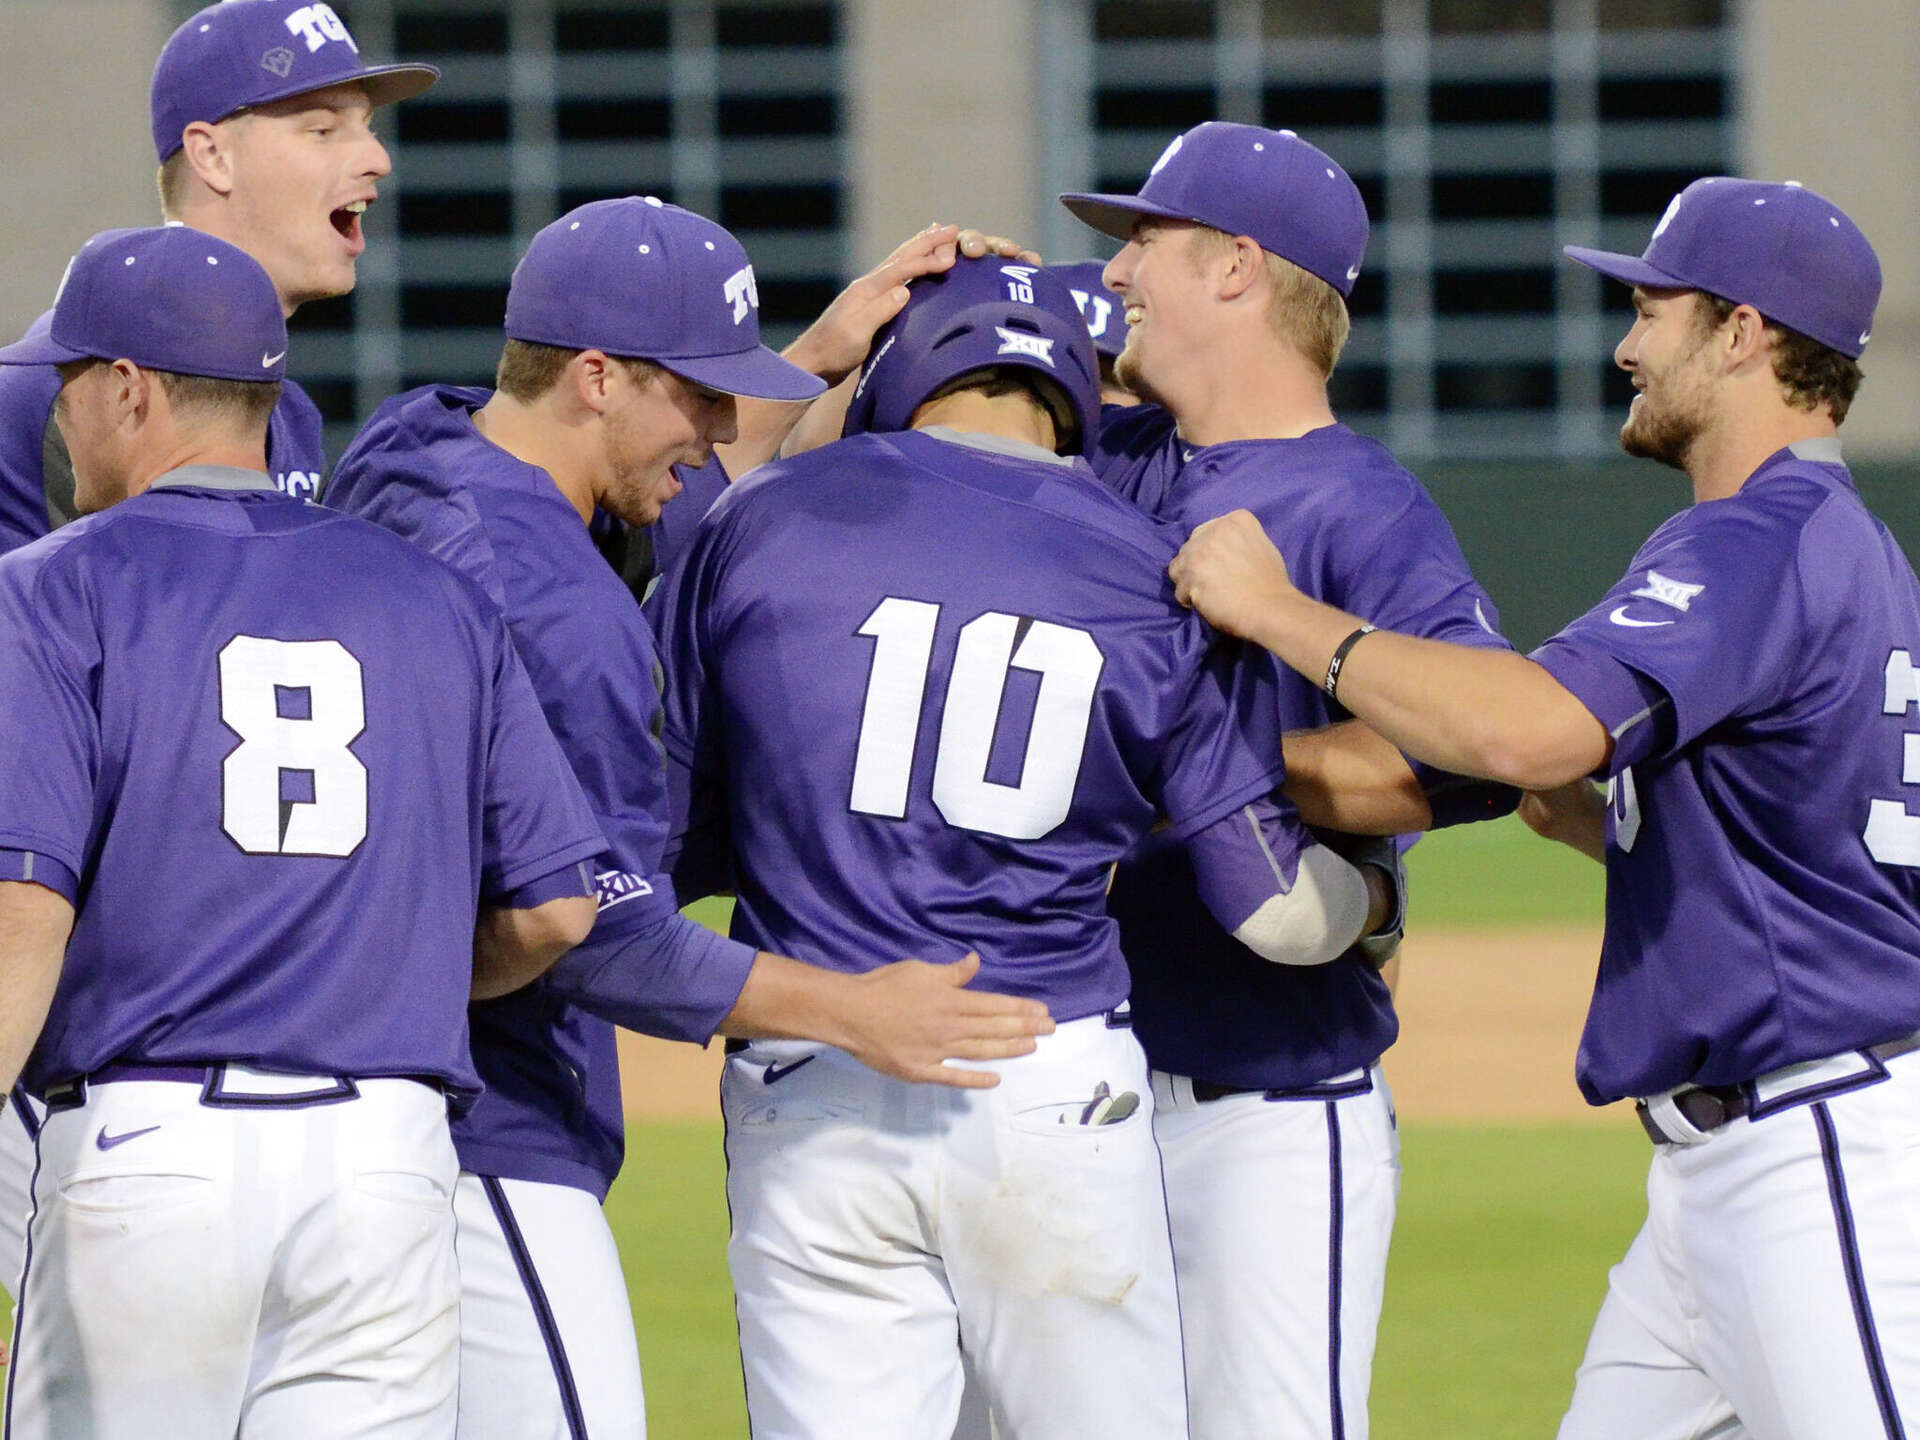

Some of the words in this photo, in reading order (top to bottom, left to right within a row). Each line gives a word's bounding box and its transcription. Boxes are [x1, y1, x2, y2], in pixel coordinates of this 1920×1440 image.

[283, 3, 359, 54] TC
[1008, 282, 1034, 304] 10
[218, 635, 368, 857] 8
[849, 598, 1105, 840] 10
